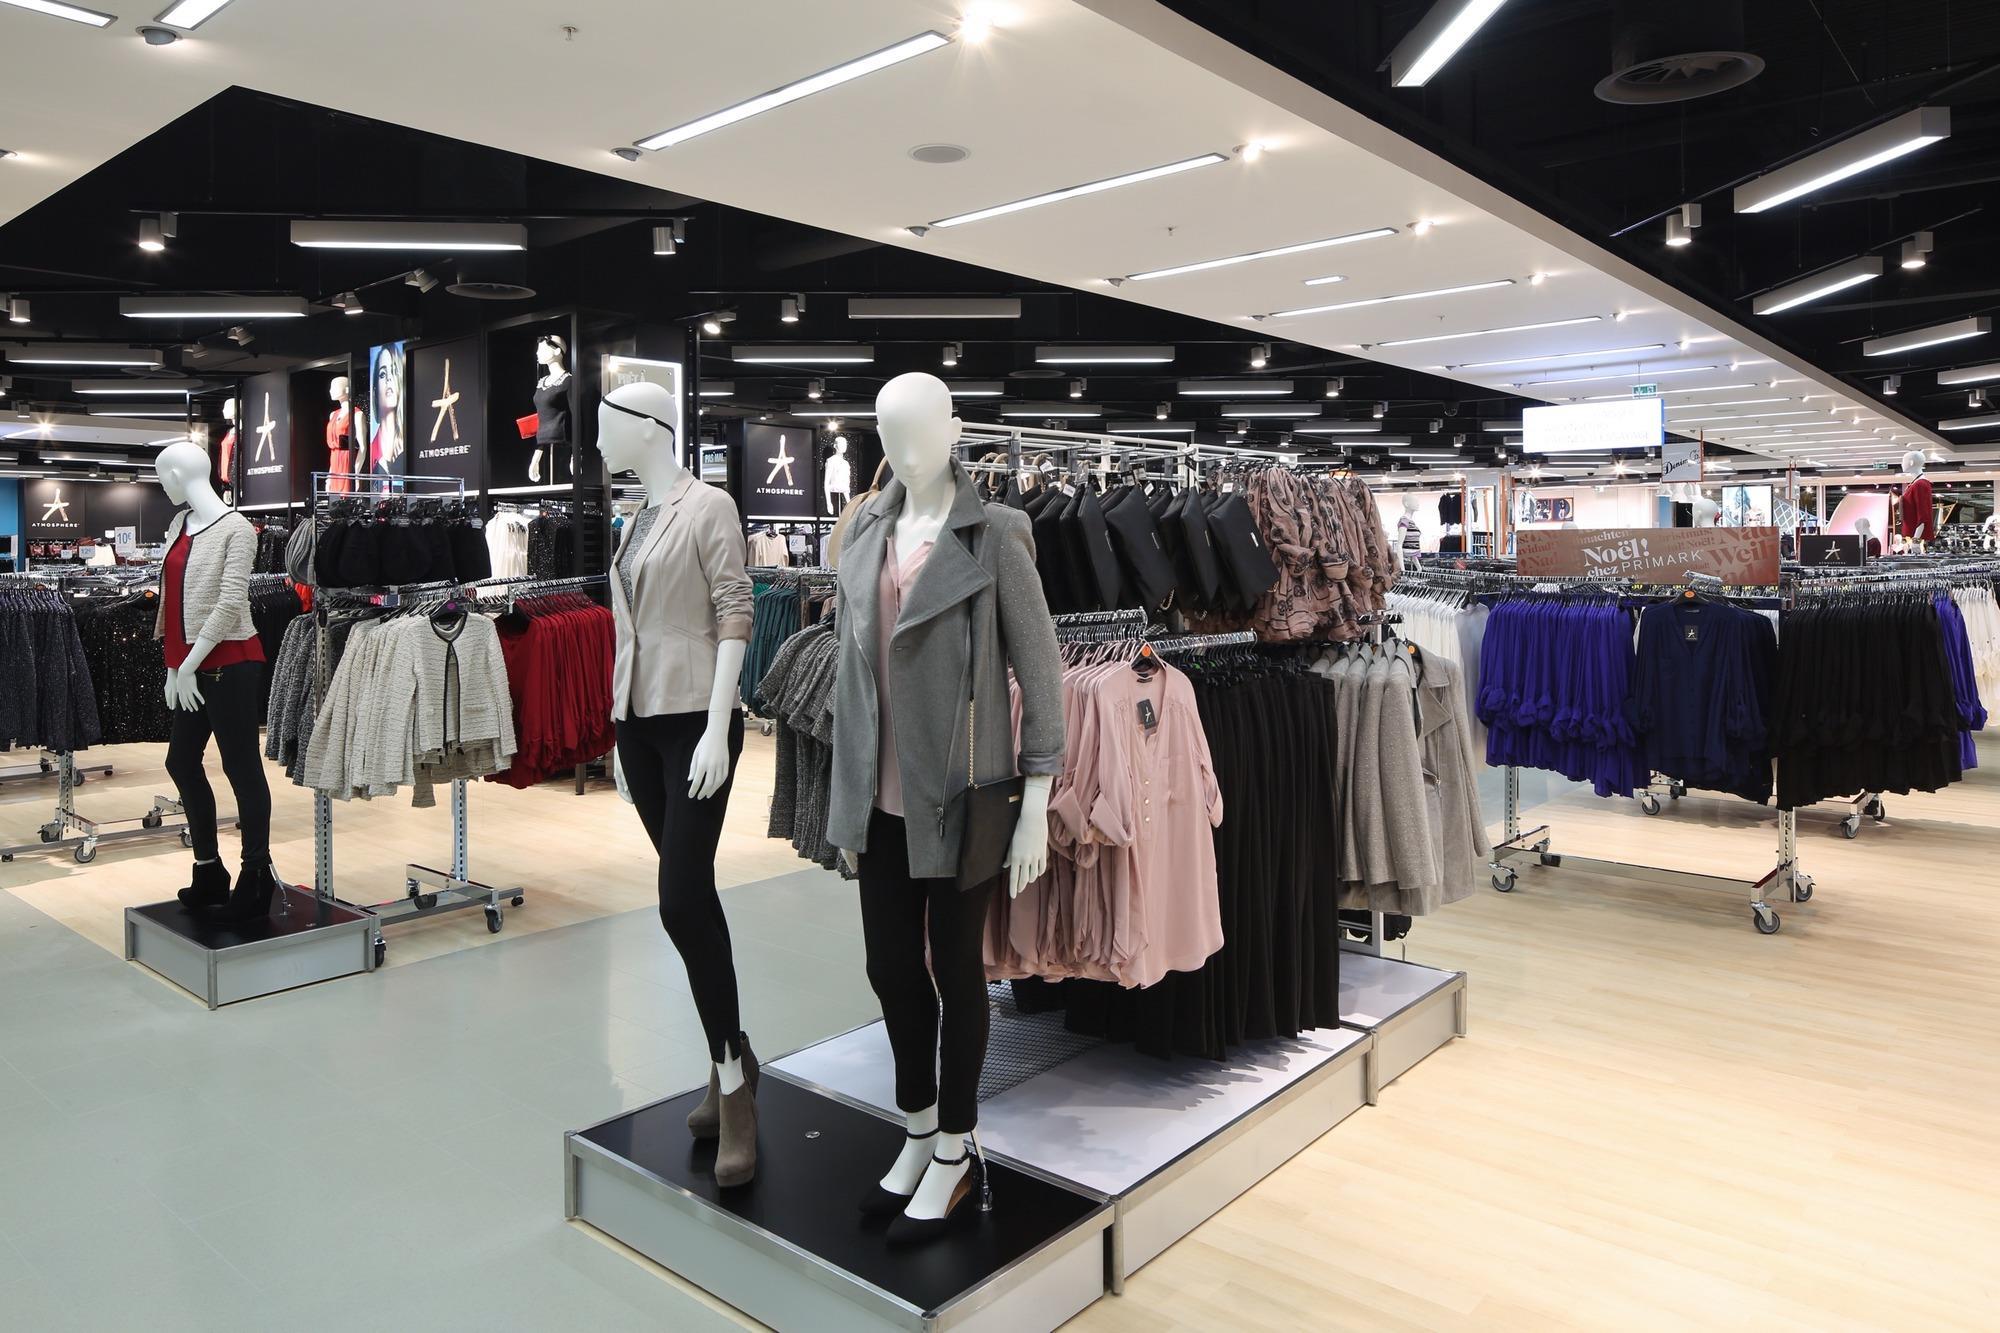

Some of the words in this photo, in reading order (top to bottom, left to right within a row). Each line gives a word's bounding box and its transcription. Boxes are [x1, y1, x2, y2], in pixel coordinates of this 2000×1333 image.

[418, 445, 471, 459] ATMOSPHERE
[247, 464, 284, 476] ATMOSPHERE
[756, 487, 804, 496] ATMOSPHERE
[1581, 538, 1650, 567] Noël!
[1587, 564, 1619, 578] chez
[1621, 550, 1703, 573] PRIMARK
